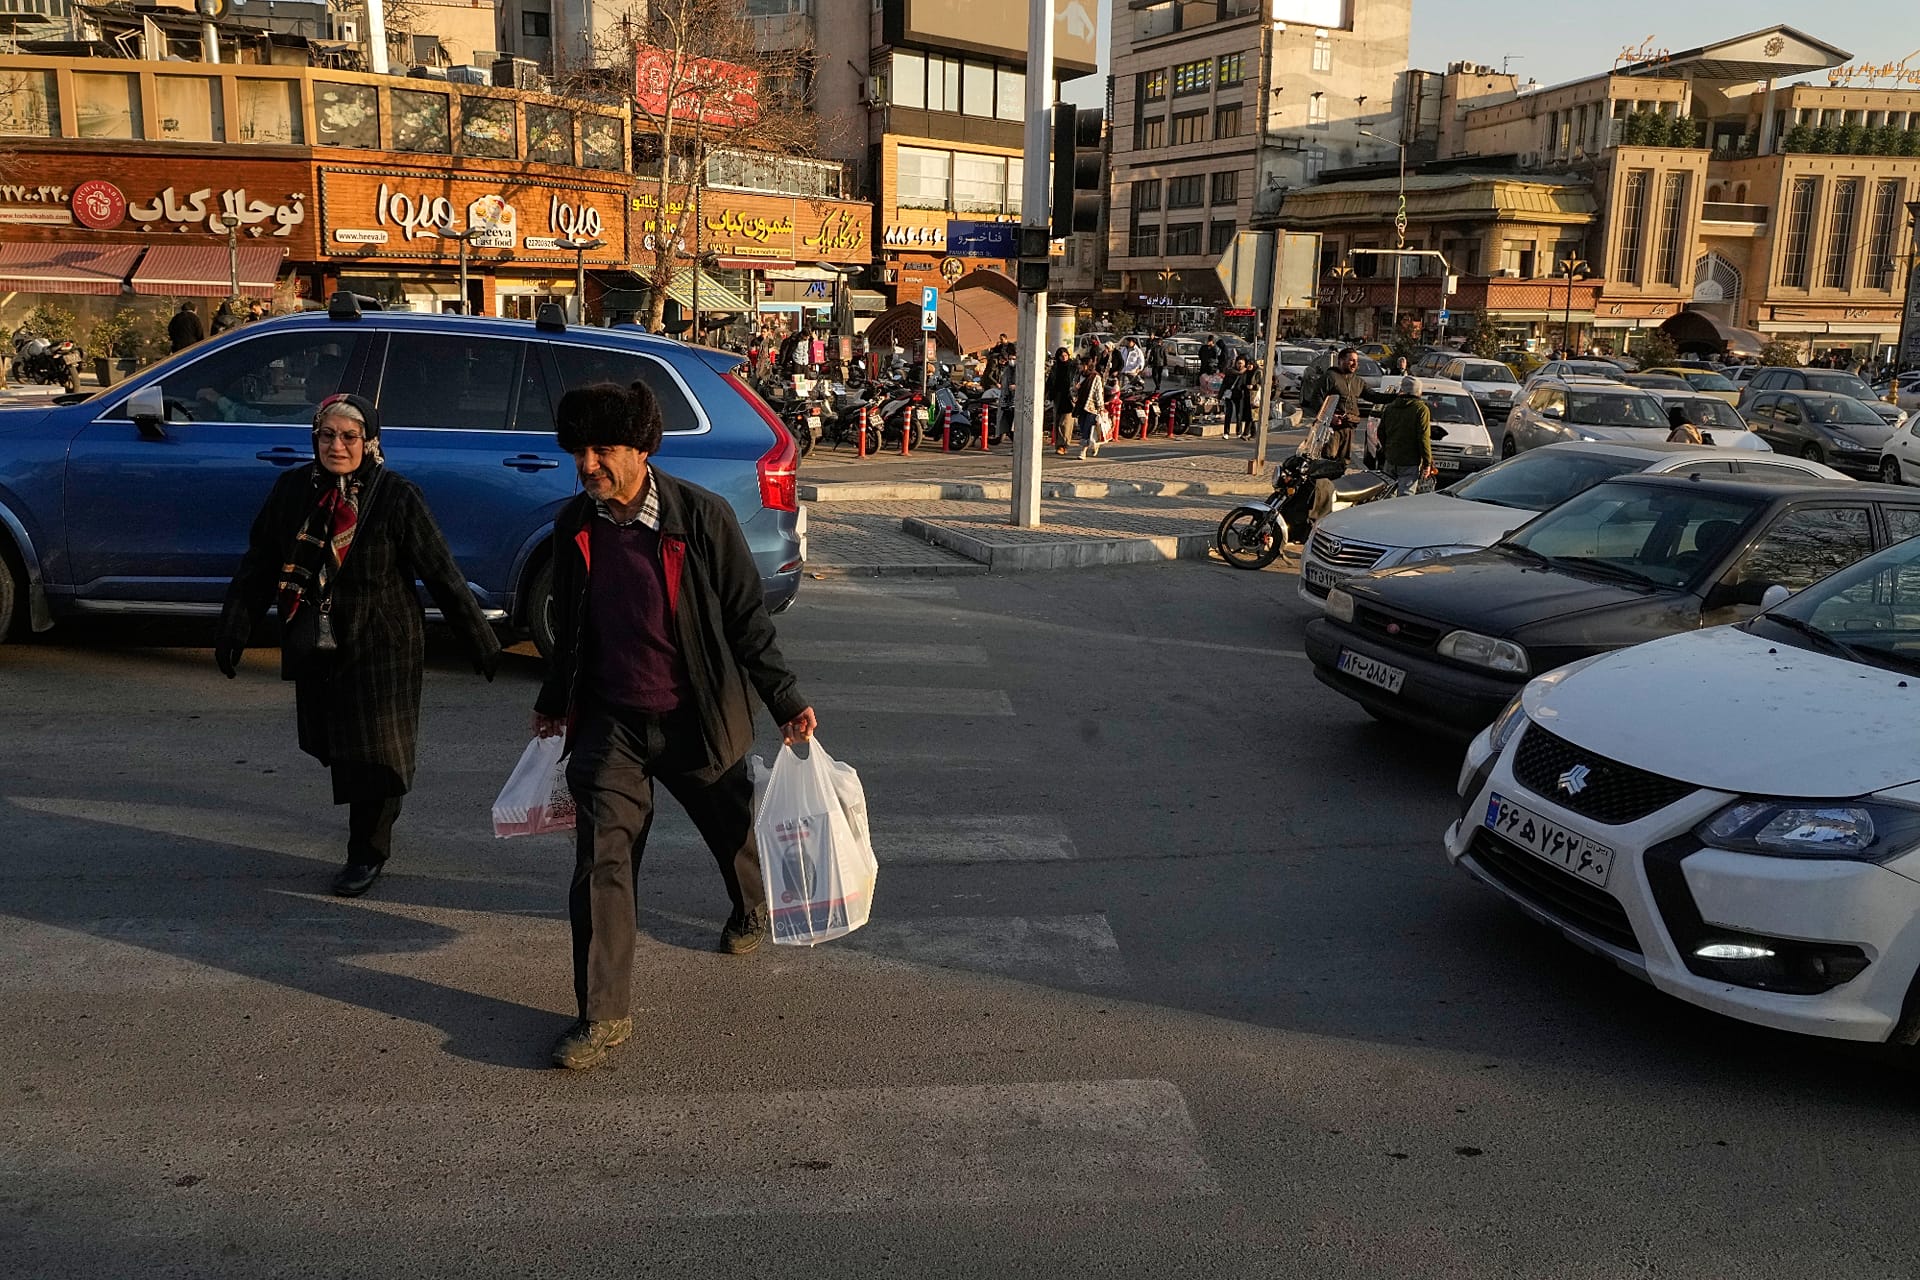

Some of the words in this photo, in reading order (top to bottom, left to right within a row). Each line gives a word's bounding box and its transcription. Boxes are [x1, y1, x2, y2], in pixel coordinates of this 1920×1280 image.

[0, 184, 69, 202] ۲۷۰۰۳۲۰
[129, 187, 211, 233] کباب
[209, 188, 305, 237] توچال
[378, 183, 461, 241] هیوا
[706, 208, 746, 237] کباب
[480, 228, 512, 238] eeva
[494, 237, 513, 247] food
[744, 216, 794, 243] شمرون
[834, 209, 864, 249] فروشگاه
[957, 231, 1003, 245] فناخسرو
[924, 289, 933, 308] P
